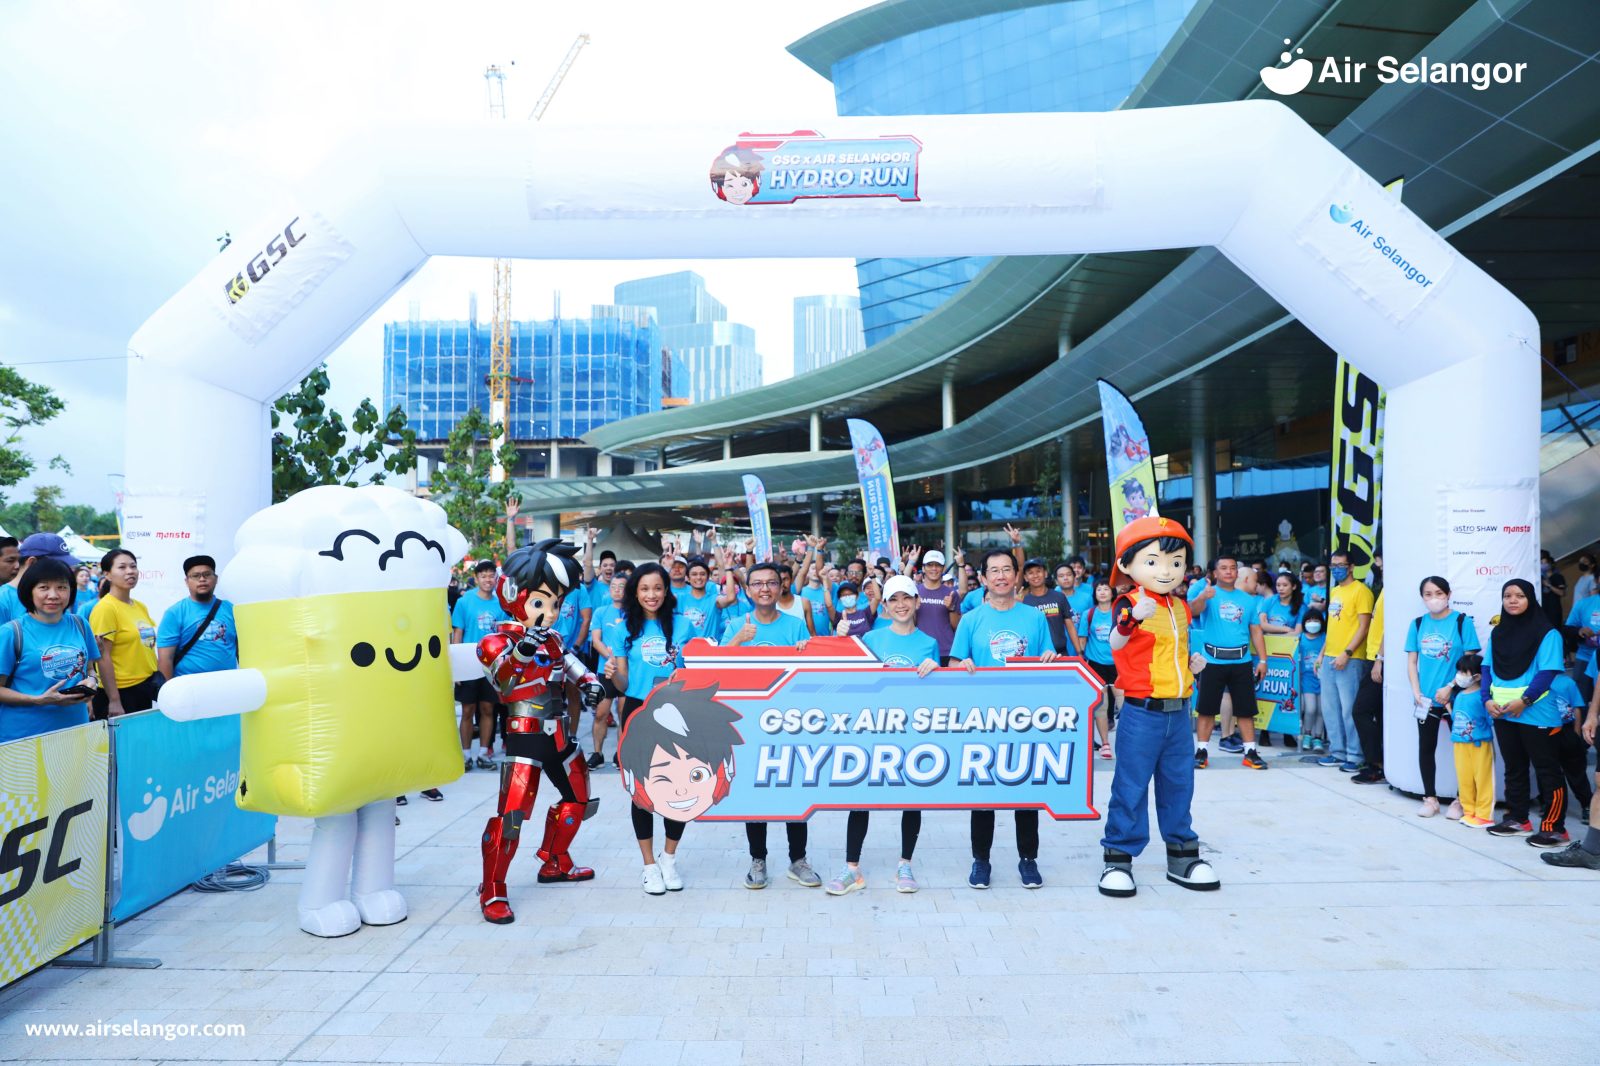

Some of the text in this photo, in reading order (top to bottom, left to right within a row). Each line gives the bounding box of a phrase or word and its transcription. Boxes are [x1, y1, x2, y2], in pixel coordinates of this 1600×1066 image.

[771, 153, 800, 165] GSC
[813, 154, 835, 164] AIR
[838, 152, 911, 164] SELANGOR
[769, 167, 909, 189] HYDRO RUN
[246, 216, 307, 284] GSC
[1350, 219, 1433, 288] Air Selangor
[1262, 680, 1288, 695] RUN
[759, 706, 1078, 733] GSC x AIR SELANGOR
[754, 741, 1075, 787] HYDRO RUN
[169, 784, 199, 818] Air
